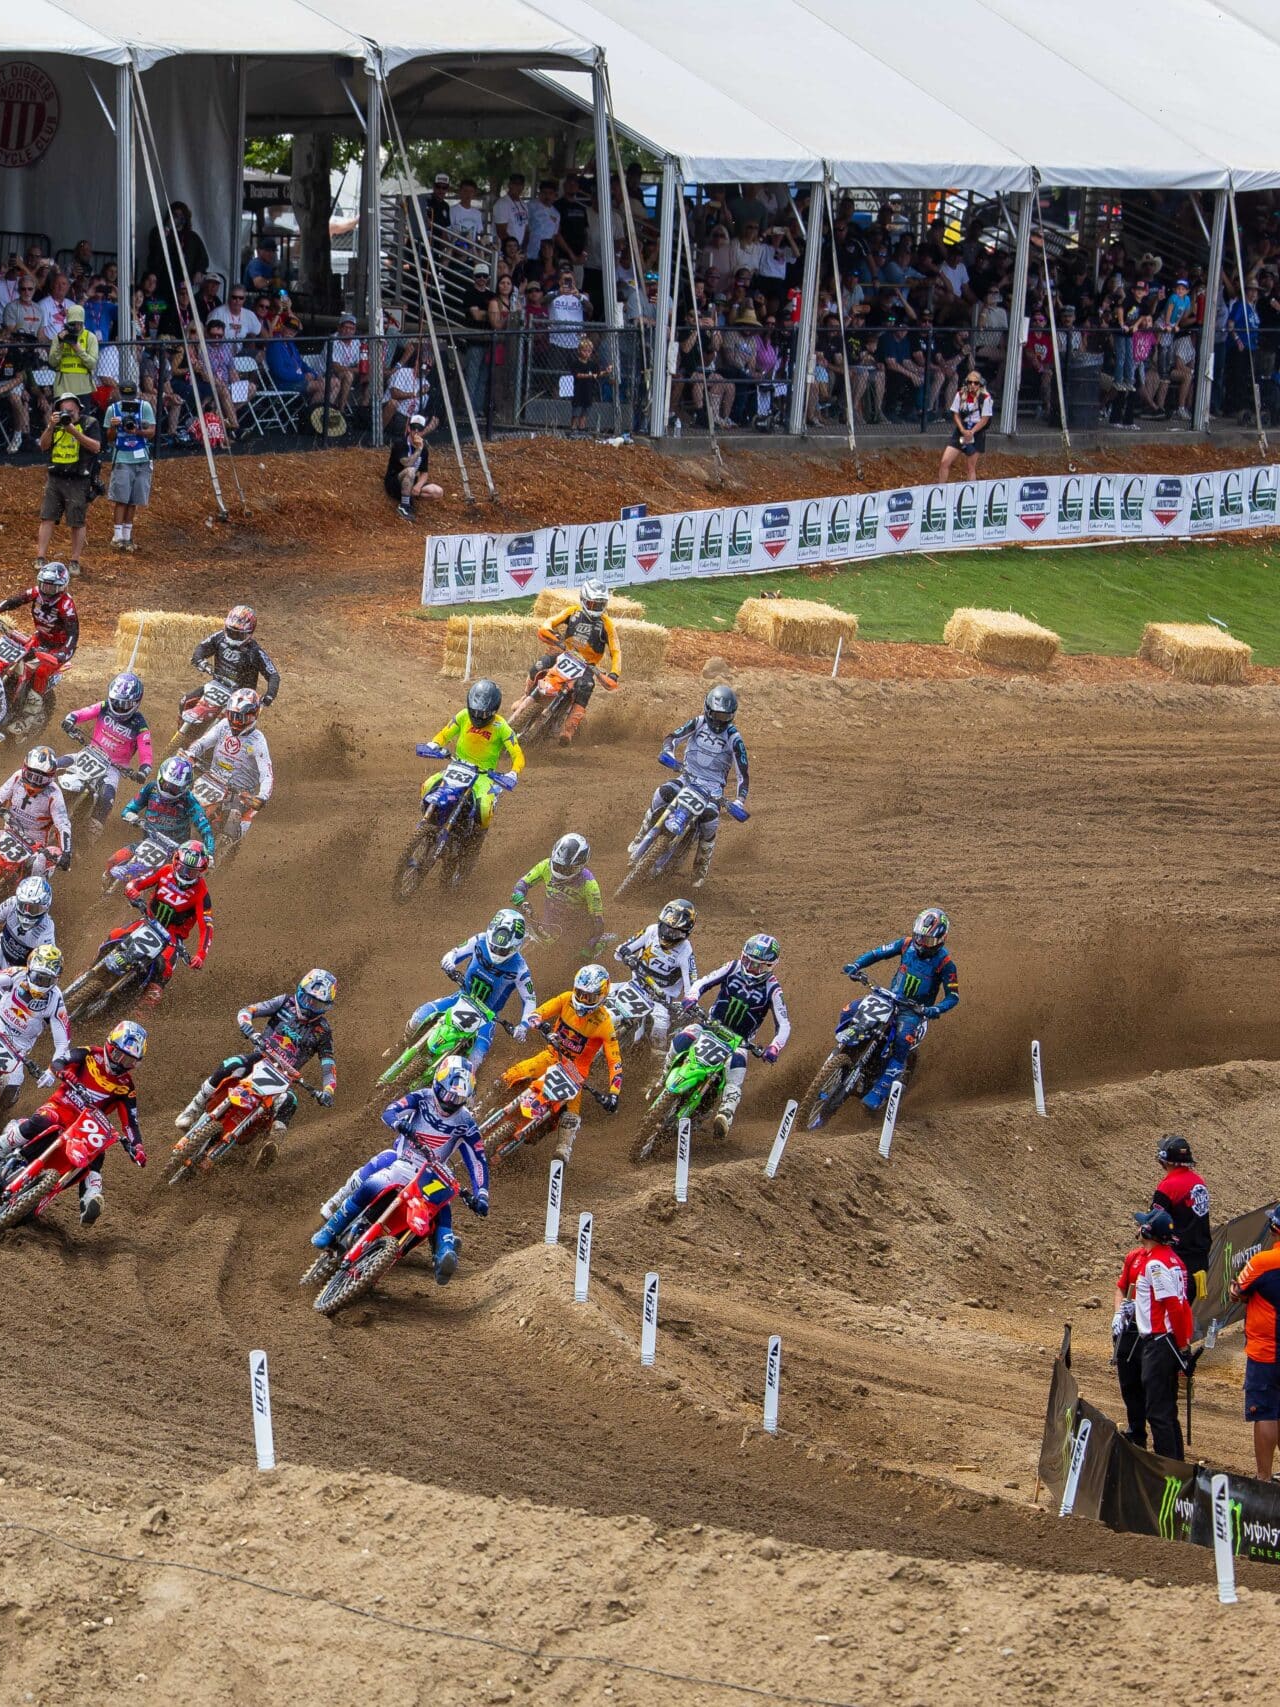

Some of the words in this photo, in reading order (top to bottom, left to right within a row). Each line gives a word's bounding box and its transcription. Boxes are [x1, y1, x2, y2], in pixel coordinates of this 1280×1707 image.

[0, 83, 38, 100] NORTH
[11, 66, 55, 101] DIGGERS
[36, 116, 57, 149] CLUB
[558, 658, 582, 678] 671
[205, 687, 228, 705] 259
[697, 732, 727, 748] FXR
[77, 753, 105, 779] 667
[194, 781, 221, 804] 418
[678, 791, 704, 811] 210
[139, 842, 165, 862] 39
[157, 887, 188, 905] FLY
[134, 931, 160, 953] 2
[617, 990, 647, 1015] 24
[4, 1010, 14, 1023] Red
[13, 1017, 28, 1030] Bull
[453, 1010, 480, 1028] 4
[694, 1038, 729, 1064] 36
[253, 1066, 286, 1088] 7
[546, 1072, 575, 1099] 26
[79, 1119, 105, 1148] 96
[422, 1180, 447, 1196] 1
[550, 1179, 558, 1207] UFO
[579, 1232, 587, 1262] UFO
[645, 1293, 653, 1323] UFO
[768, 1355, 776, 1388] UFO
[254, 1377, 264, 1415] UFO
[1215, 1503, 1225, 1541] UFO
